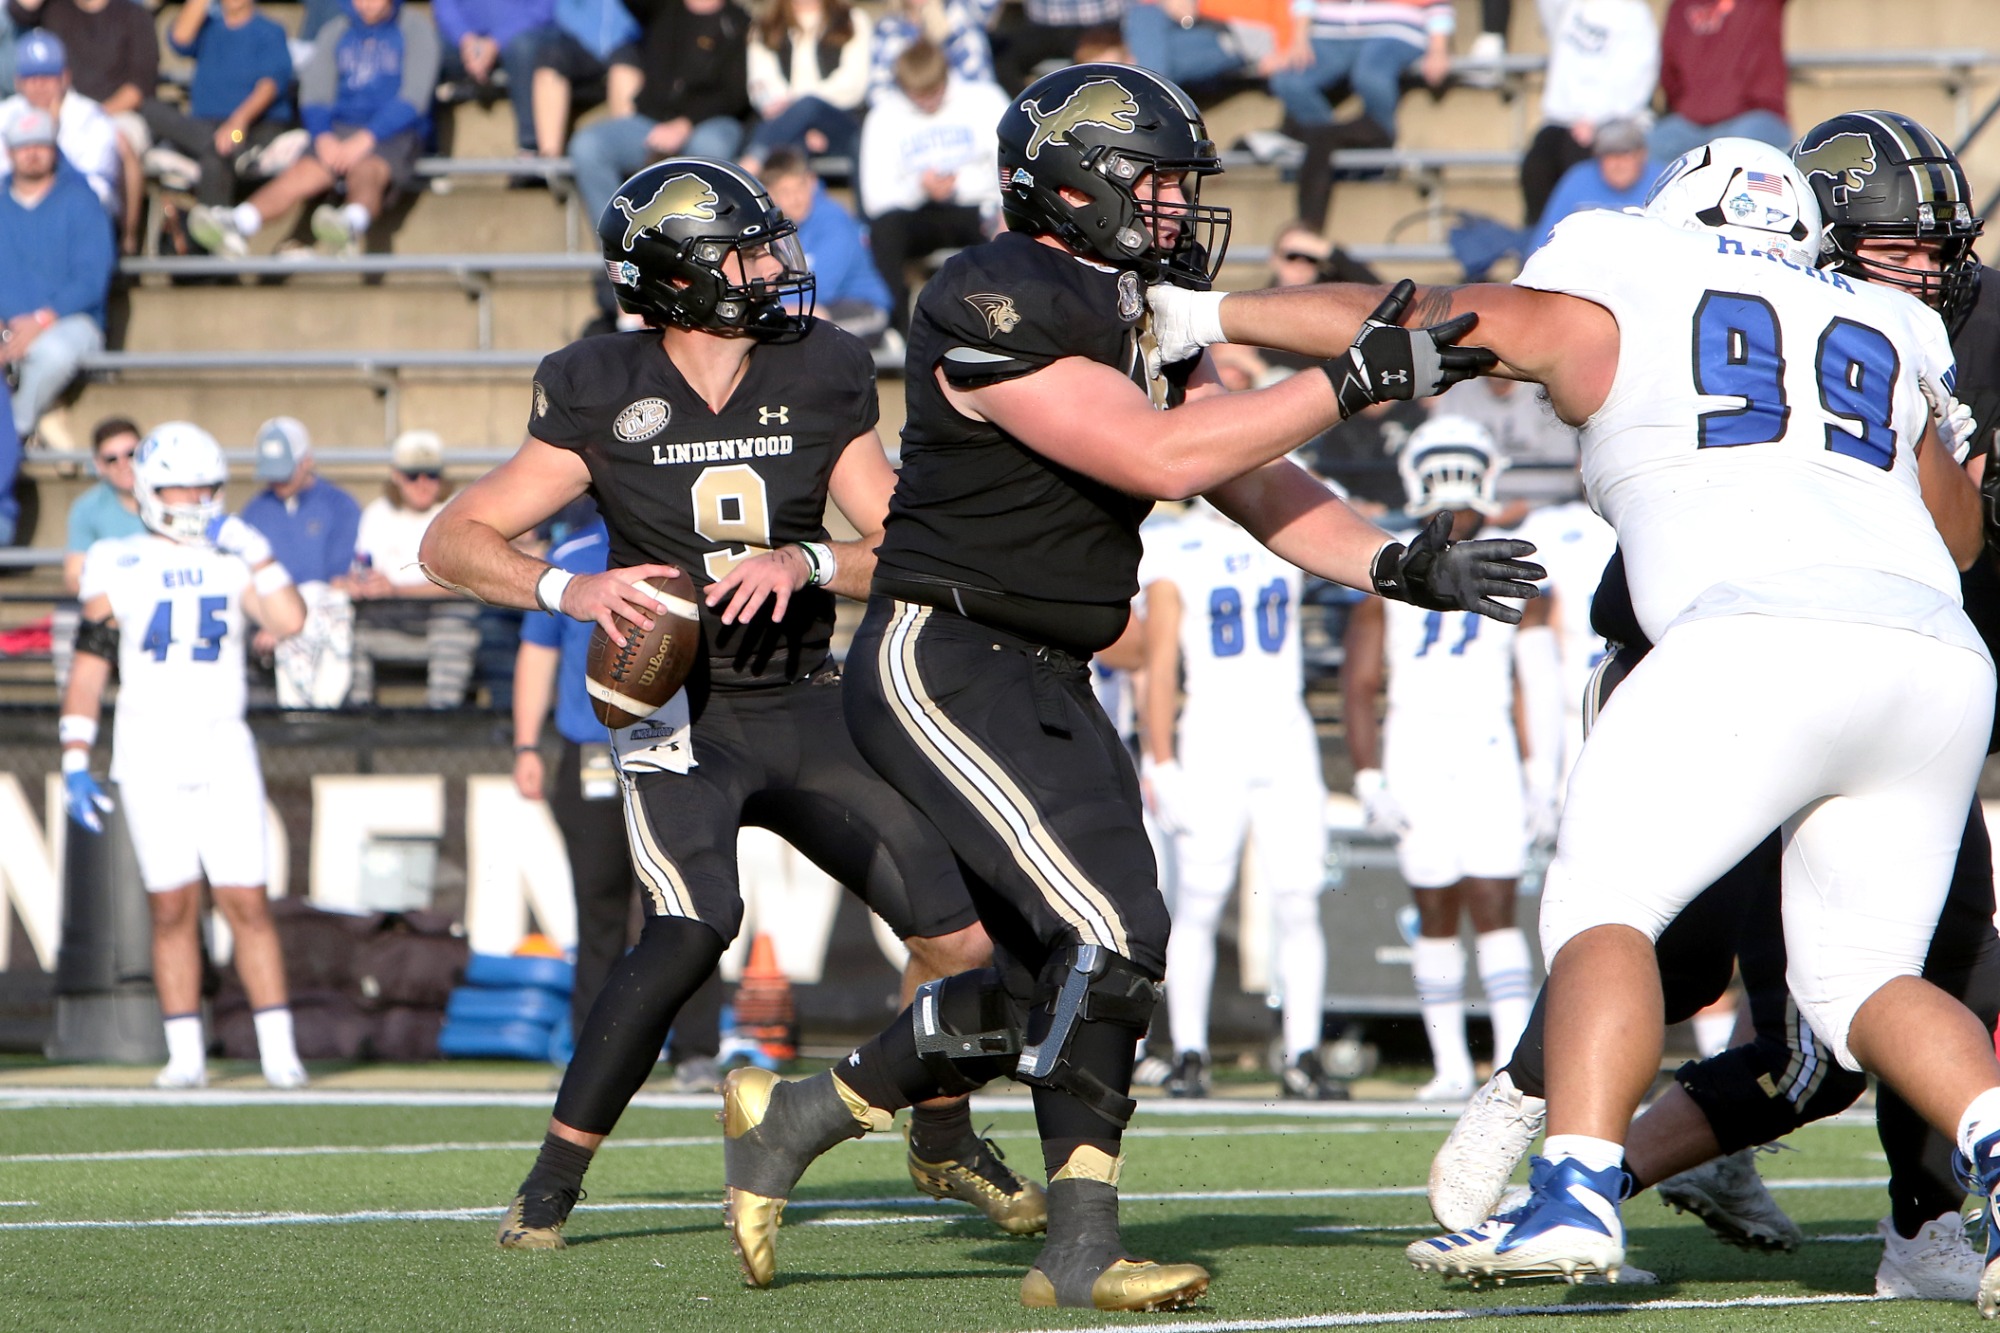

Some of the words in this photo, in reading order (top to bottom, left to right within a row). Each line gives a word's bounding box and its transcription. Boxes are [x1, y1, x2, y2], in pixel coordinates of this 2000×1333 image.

[1691, 288, 1901, 473] 99
[625, 405, 661, 434] OVC
[652, 435, 793, 465] LINDENWOOD
[691, 463, 774, 583] 9
[163, 568, 204, 589] EIU
[140, 595, 229, 663] 45
[1207, 577, 1289, 657] 80
[638, 632, 672, 687] Wilson
